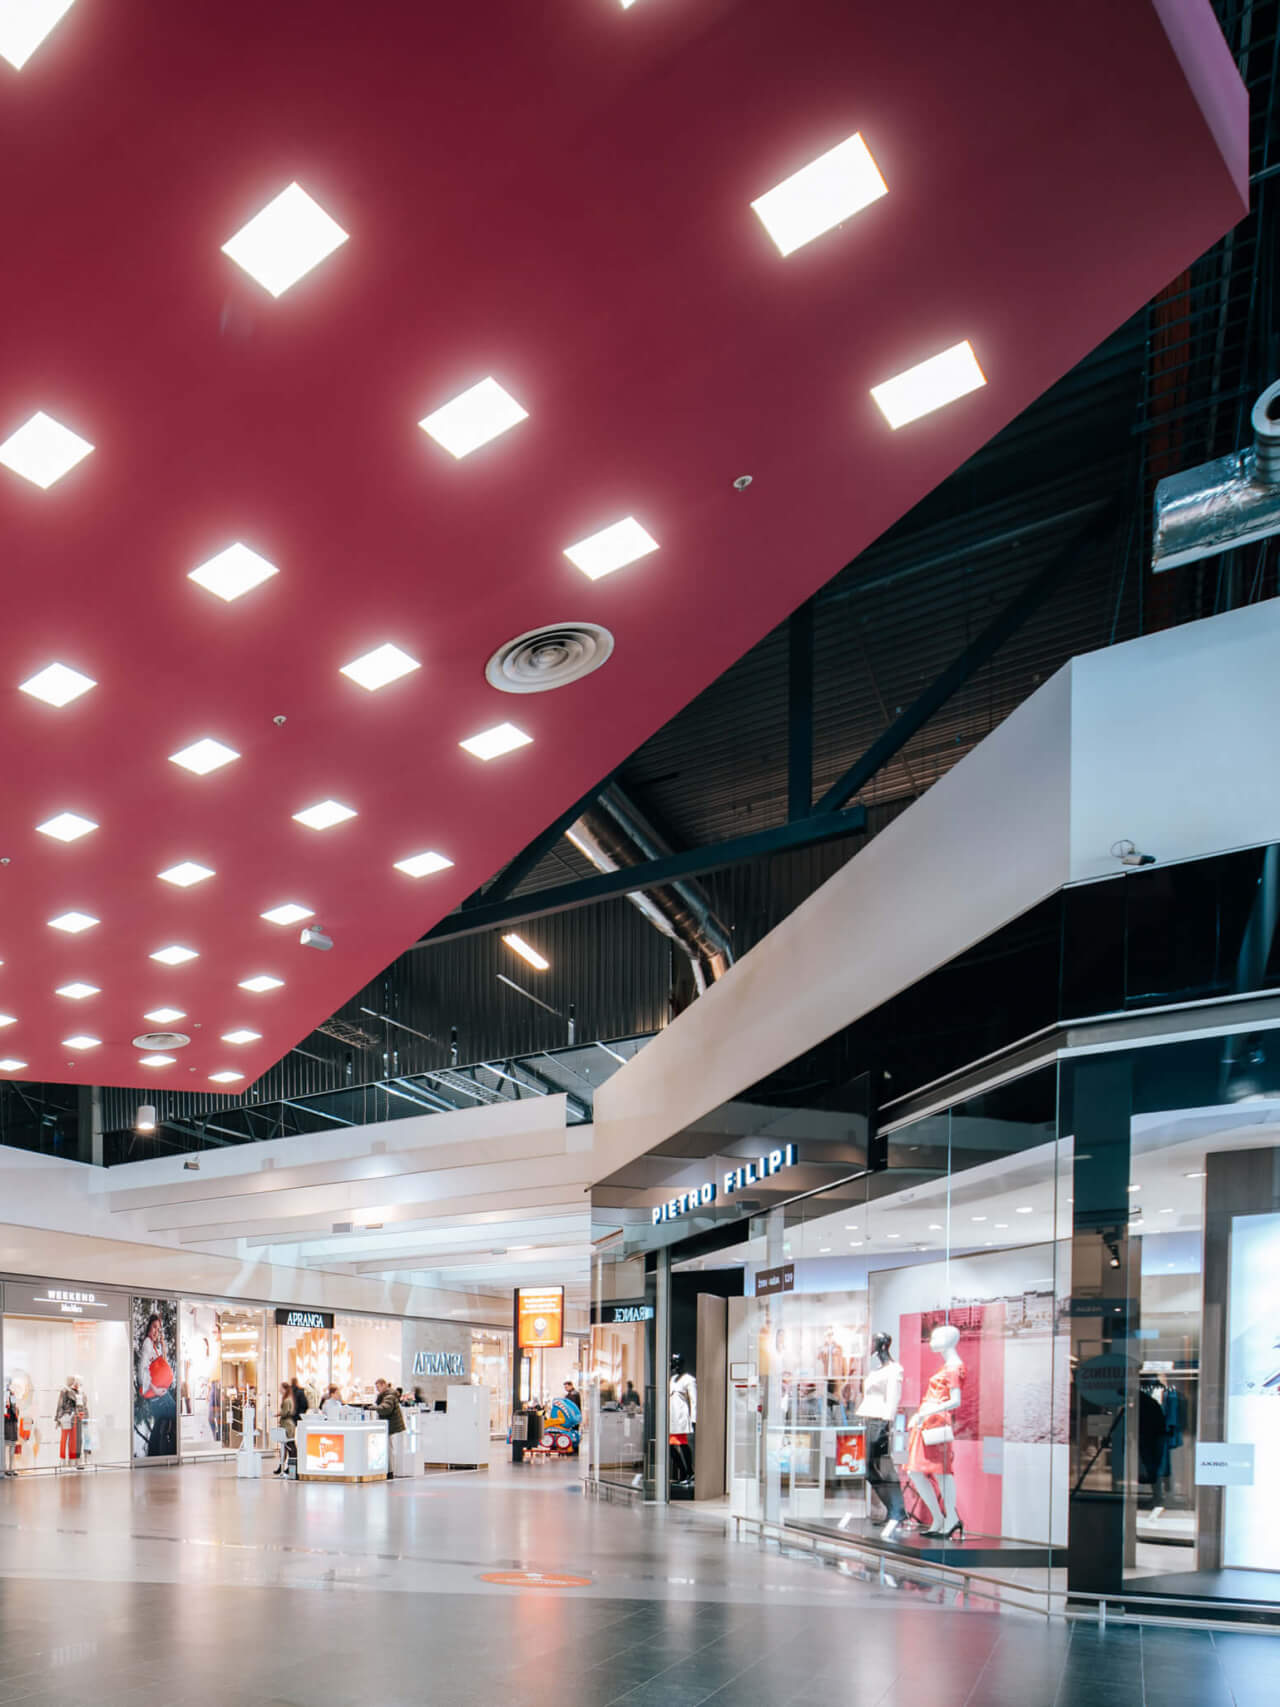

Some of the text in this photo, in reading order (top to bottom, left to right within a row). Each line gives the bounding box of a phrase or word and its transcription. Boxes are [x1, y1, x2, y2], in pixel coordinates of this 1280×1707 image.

[652, 1144, 798, 1225] PIETRO FILIPI
[47, 1290, 96, 1302] WEEKEND
[287, 1312, 325, 1328] APRANGA
[412, 1351, 465, 1376] APRANGA
